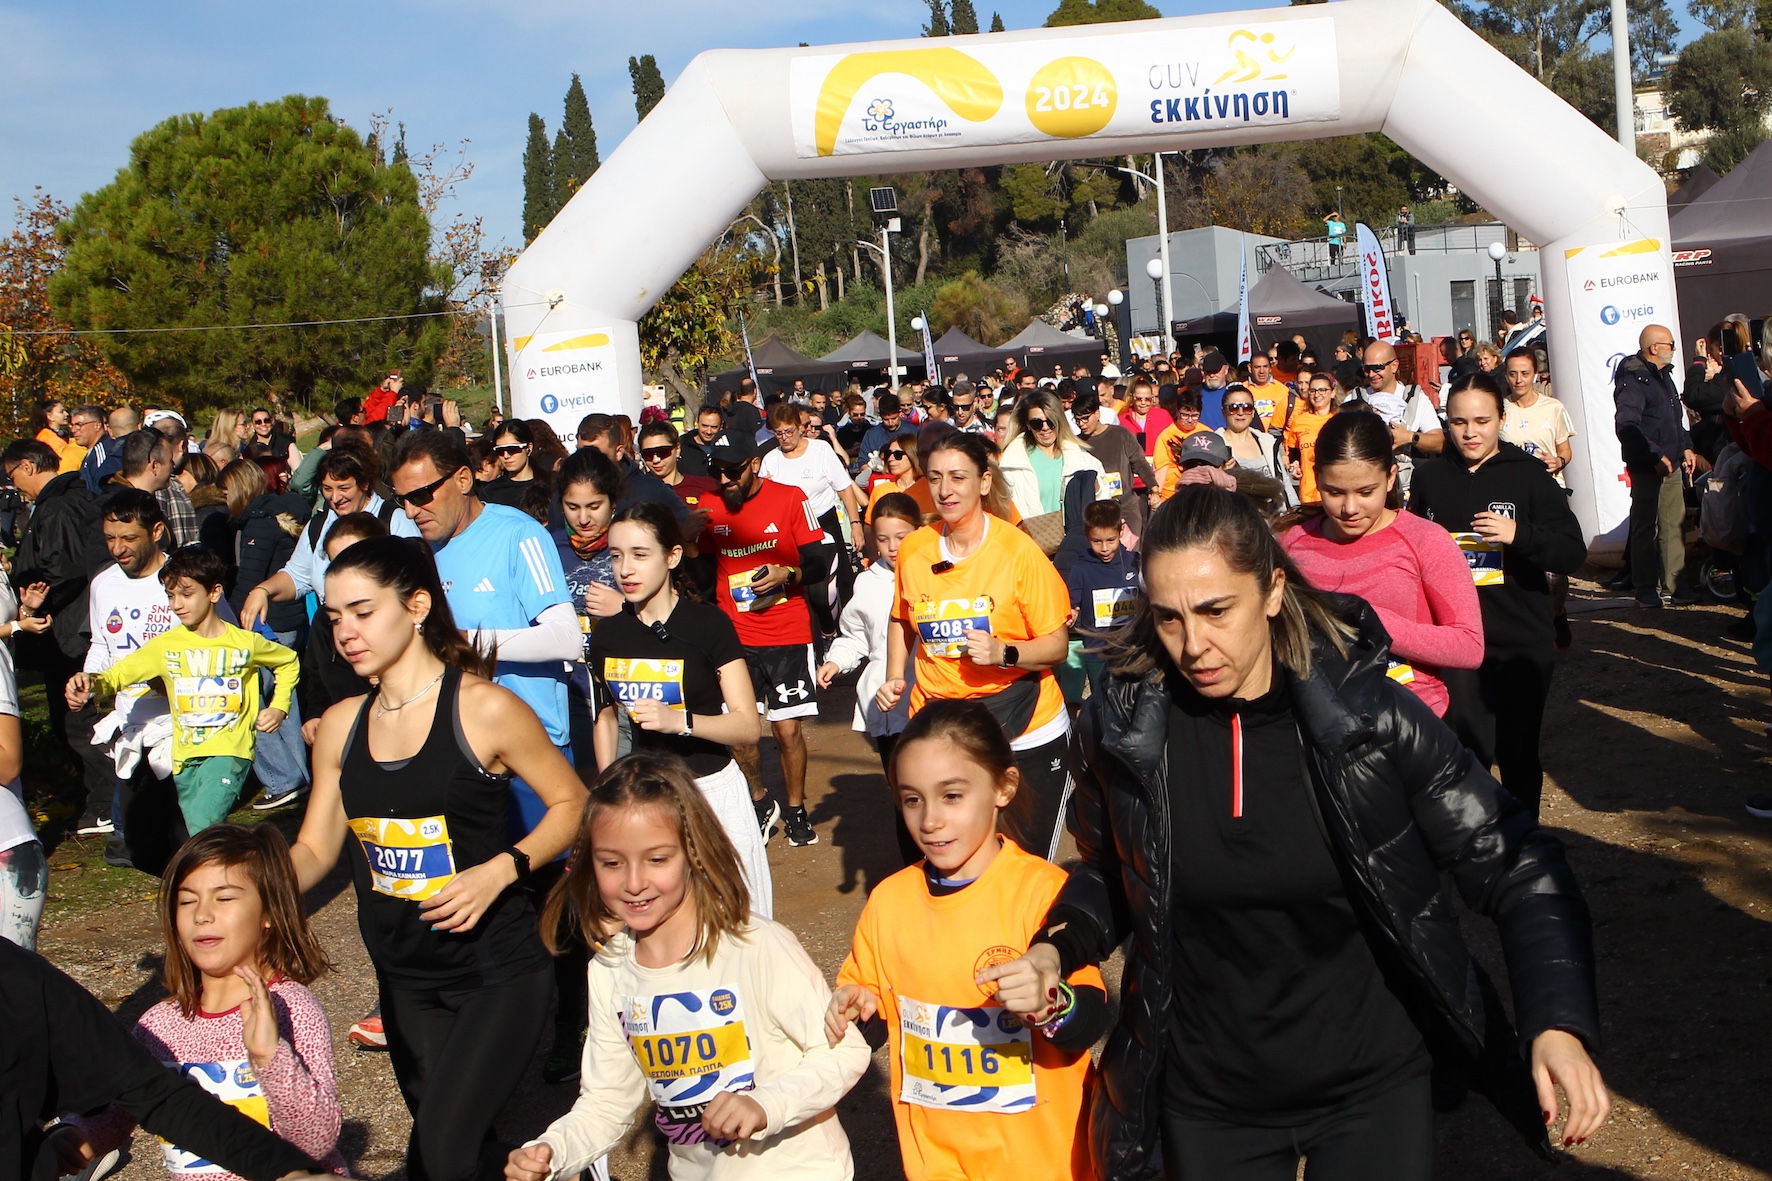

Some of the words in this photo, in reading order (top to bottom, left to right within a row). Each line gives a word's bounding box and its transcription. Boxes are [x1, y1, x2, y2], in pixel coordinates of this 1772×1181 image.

[1149, 61, 1199, 90] συν
[1035, 84, 1109, 112] 2024
[1150, 88, 1289, 123] εκκίνηση
[861, 118, 878, 131] Το
[882, 116, 947, 135] Εργαστήρι
[1600, 272, 1660, 288] EUROBANK
[1622, 304, 1654, 320] υγεία
[540, 361, 603, 377] EUROBANK
[560, 393, 595, 409] υγεία
[1192, 435, 1213, 451] NY
[721, 539, 778, 557] #BERLINHALF
[147, 613, 171, 623] RUN
[930, 619, 974, 637] 2083
[184, 647, 251, 677] WIN
[618, 682, 664, 700] 2076
[189, 695, 227, 708] 1073
[375, 846, 424, 871] 2077
[986, 947, 1012, 956] ΕΡΜΗΣ
[642, 1033, 717, 1067] 1070
[923, 1043, 999, 1075] 1116
[689, 1061, 724, 1075] ΠΑΠΠΑ
